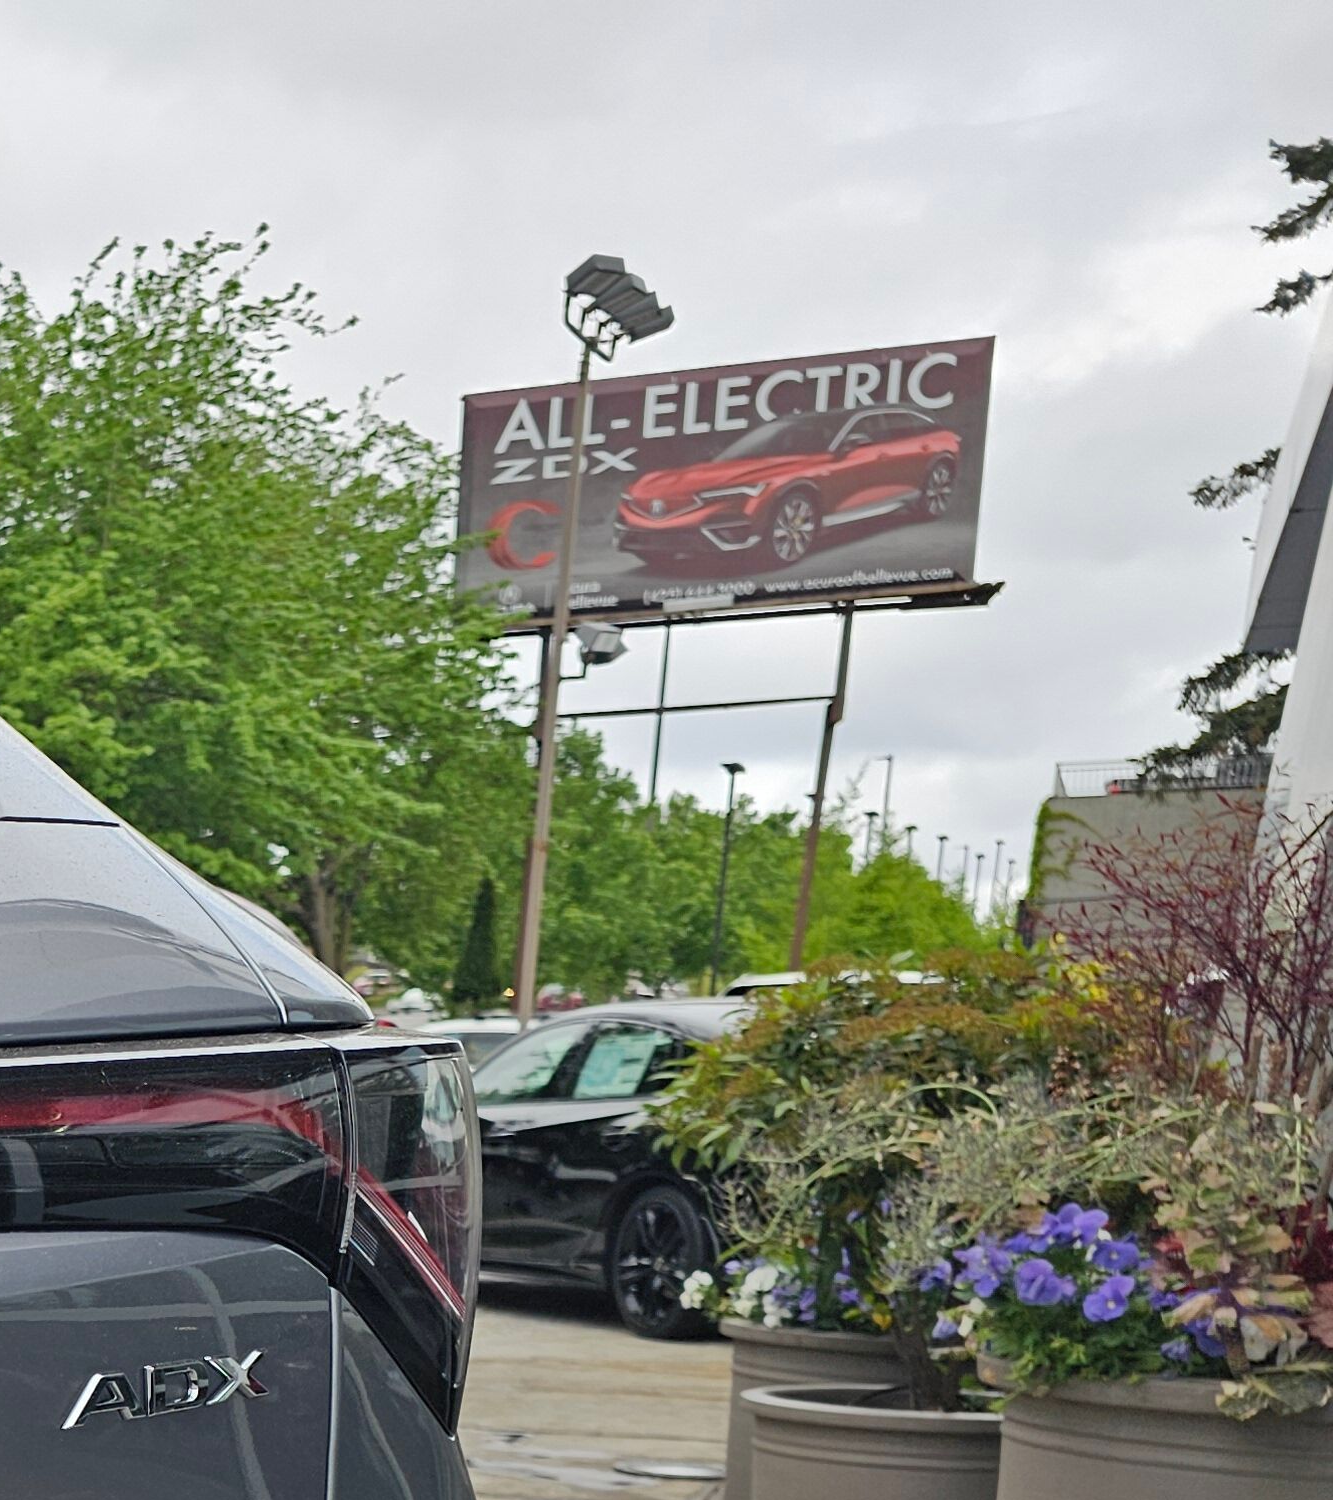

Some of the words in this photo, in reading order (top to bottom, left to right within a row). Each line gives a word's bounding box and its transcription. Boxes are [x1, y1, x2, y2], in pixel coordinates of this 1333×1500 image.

[493, 352, 959, 455] ALL-ELECTRIC
[489, 446, 639, 486] ZDX
[60, 1349, 270, 1430] ADX
